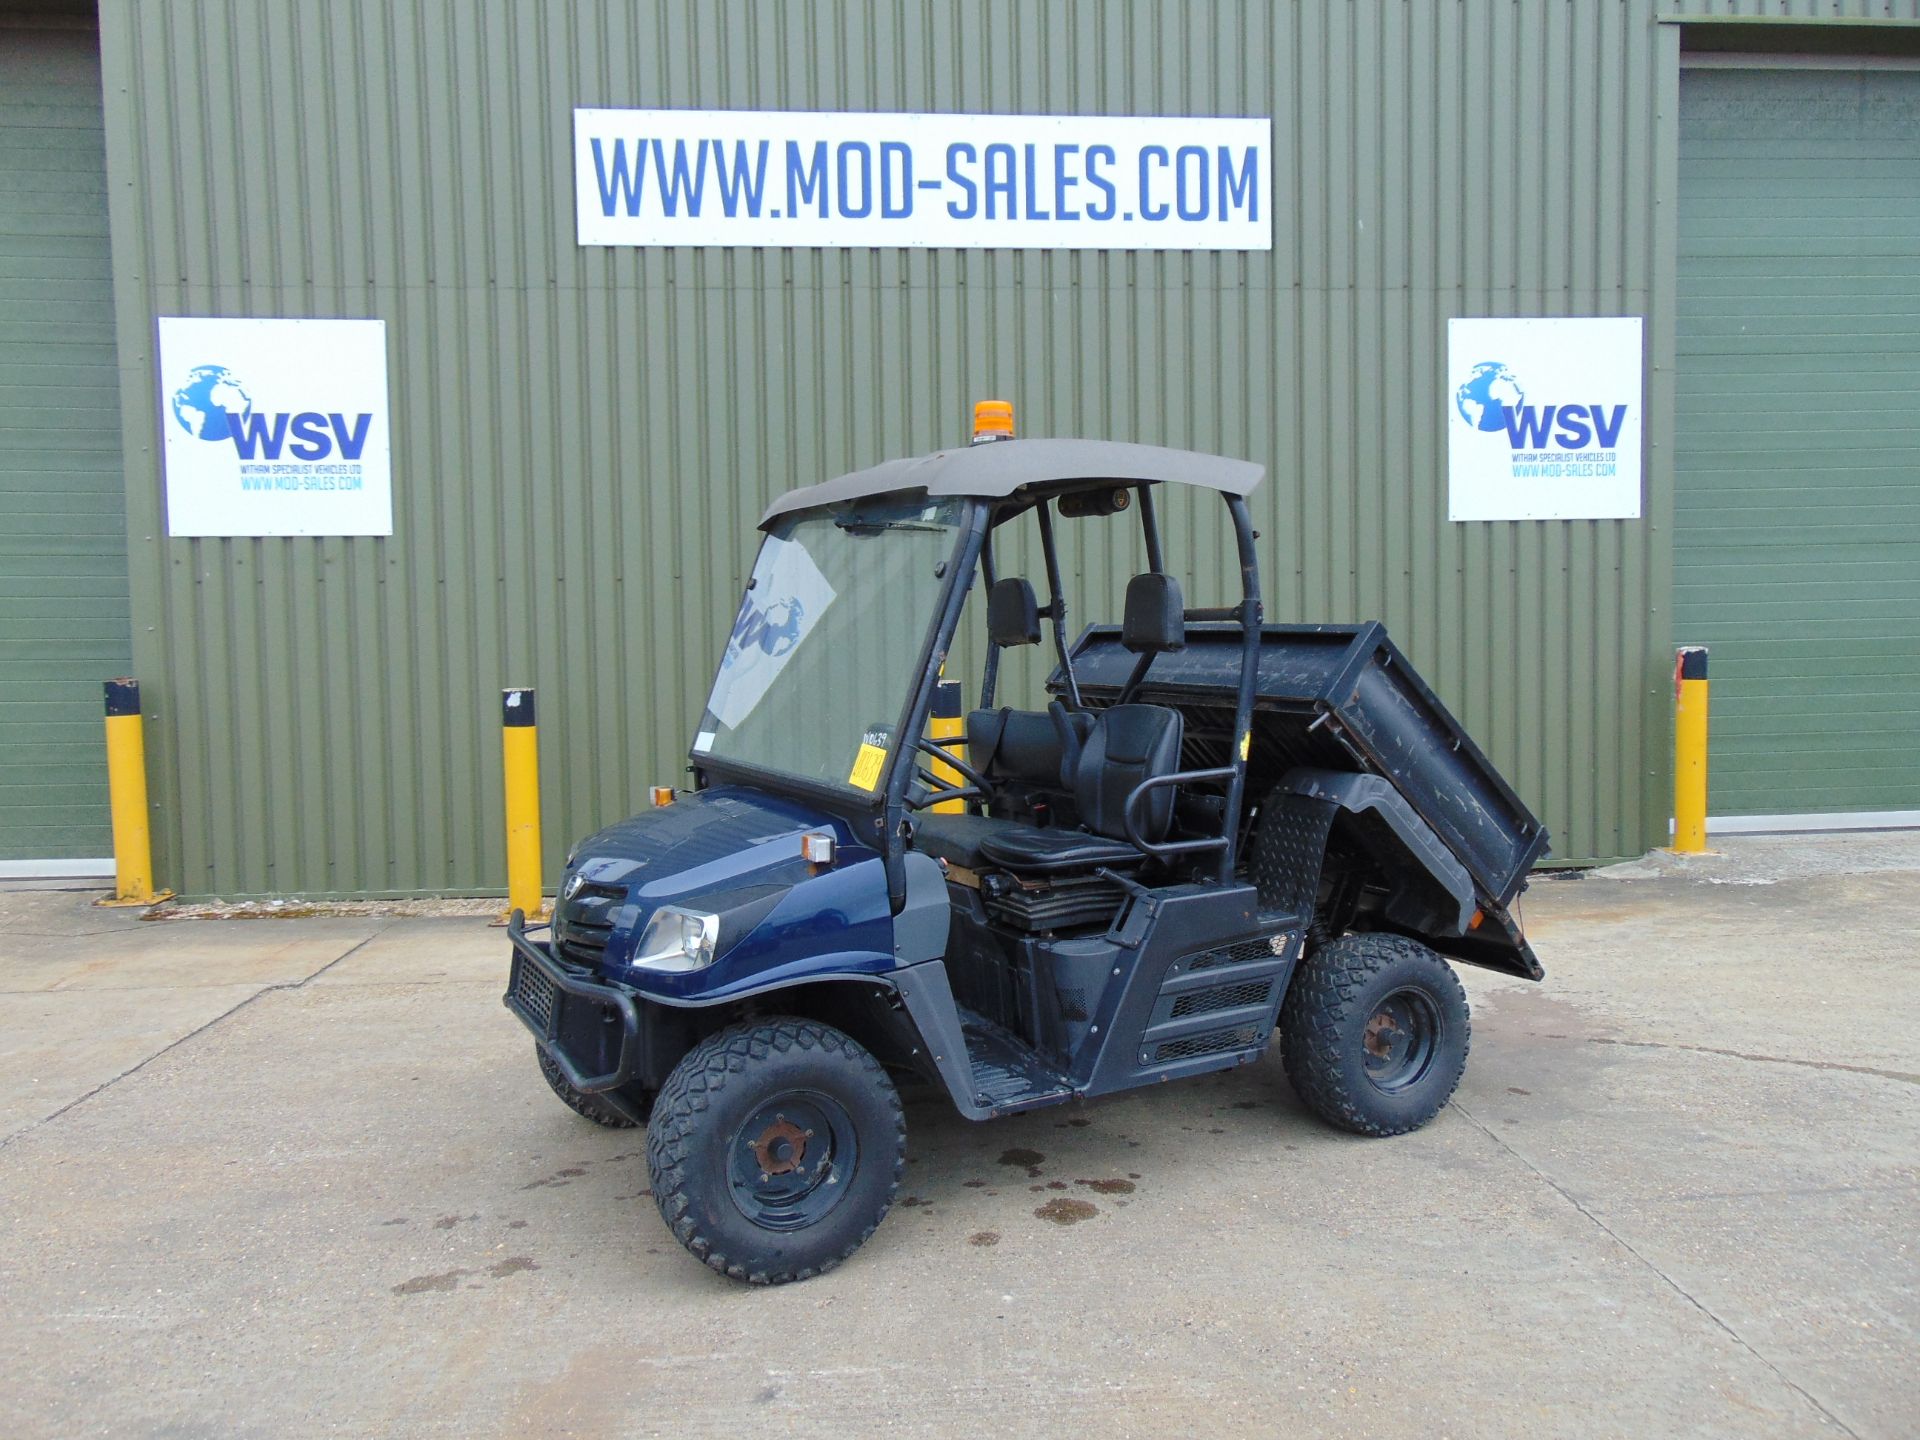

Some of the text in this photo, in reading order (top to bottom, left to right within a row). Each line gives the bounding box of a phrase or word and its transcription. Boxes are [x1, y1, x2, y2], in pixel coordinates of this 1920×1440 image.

[589, 137, 1259, 222] WWW.MOD-SALES.COM
[1502, 404, 1628, 450] WSV
[225, 411, 373, 461] WSV
[1512, 452, 1616, 462] WITHAM SPECIALIST VEHICLES LTD
[240, 464, 361, 474] WITHAM SPECIALIST VEHICLES LTD
[1512, 464, 1616, 477] WWWMOD-SALESCOM
[241, 476, 362, 490] WWWMOD-SALESCOM
